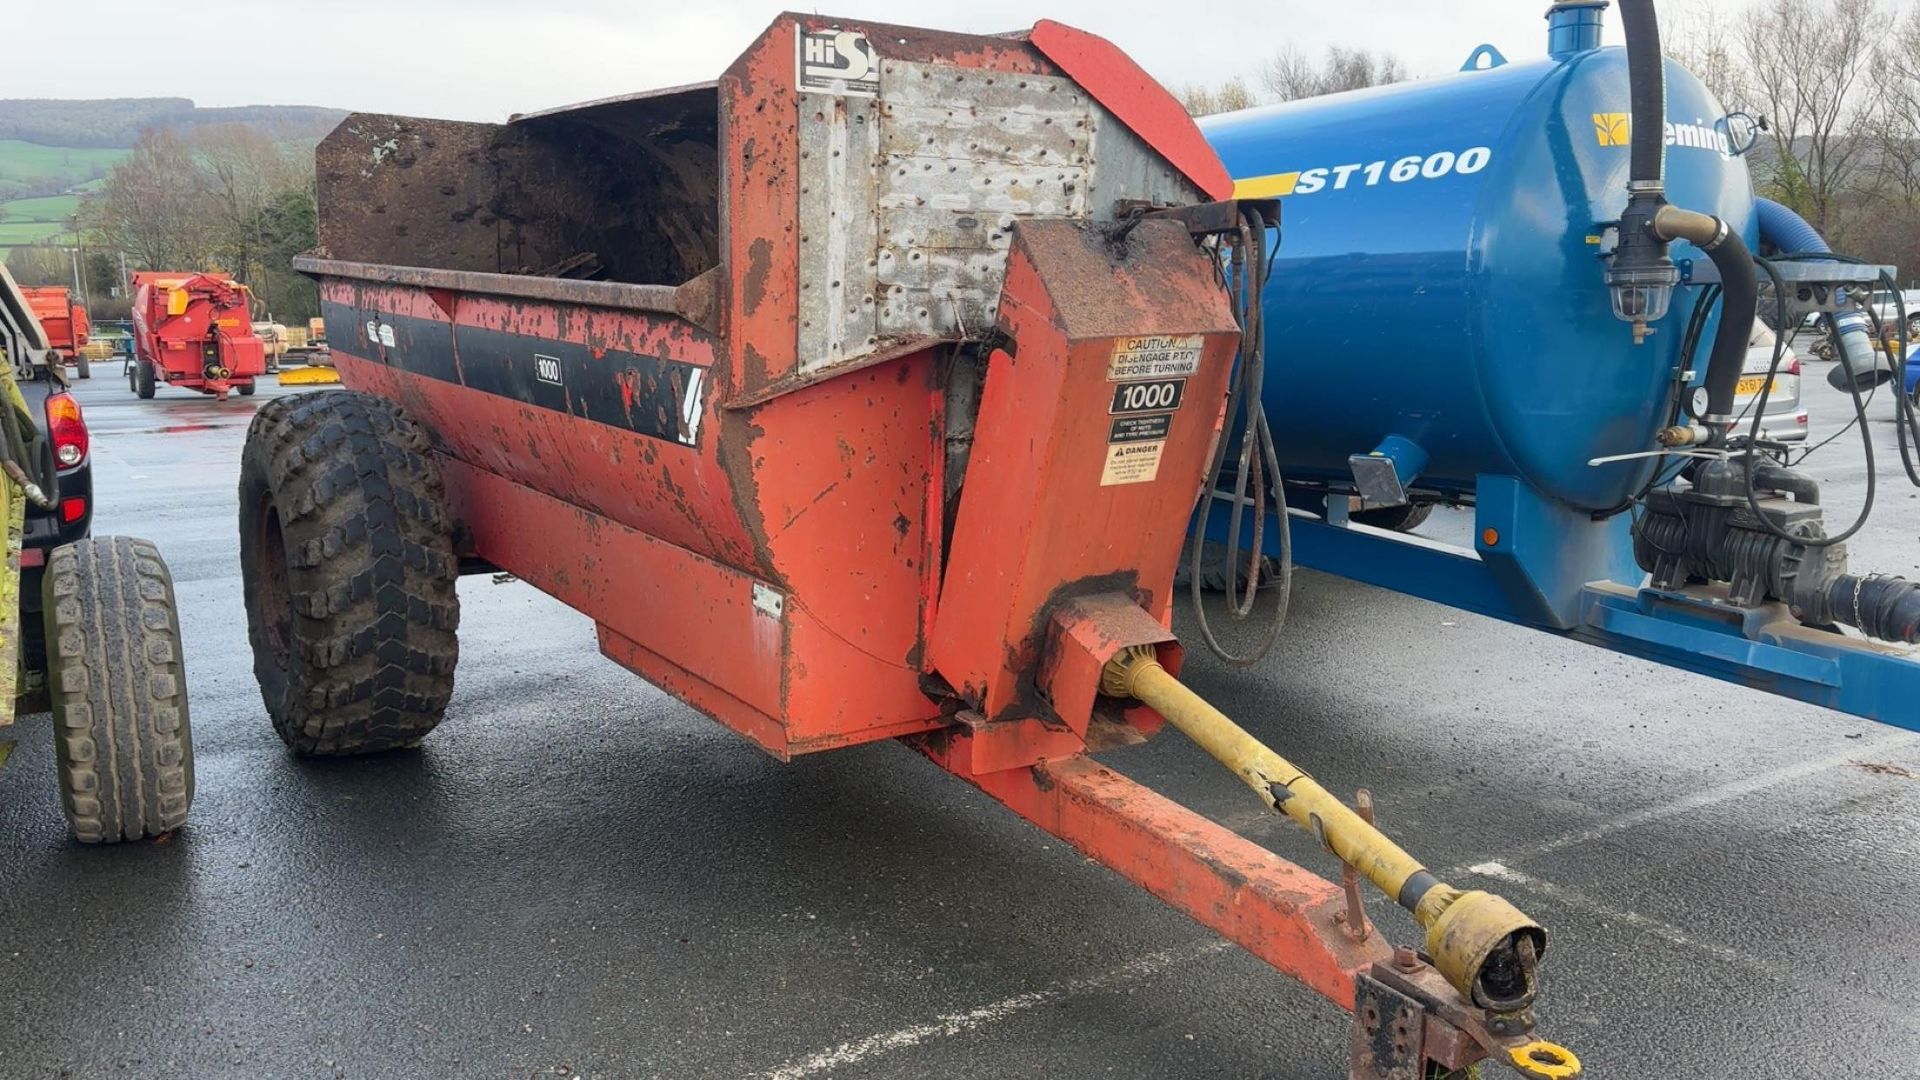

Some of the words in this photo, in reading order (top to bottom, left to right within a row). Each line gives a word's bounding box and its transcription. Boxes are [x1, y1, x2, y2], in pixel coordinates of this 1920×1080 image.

[1629, 113, 1731, 161] eming
[1294, 146, 1491, 194] ST1600
[1127, 338, 1177, 350] CAUTION
[538, 359, 558, 381] 1000
[1114, 365, 1152, 375] BEFORE
[1153, 362, 1193, 373] TURNING
[1123, 383, 1175, 409] 1000
[1125, 445, 1158, 454] DANGER
